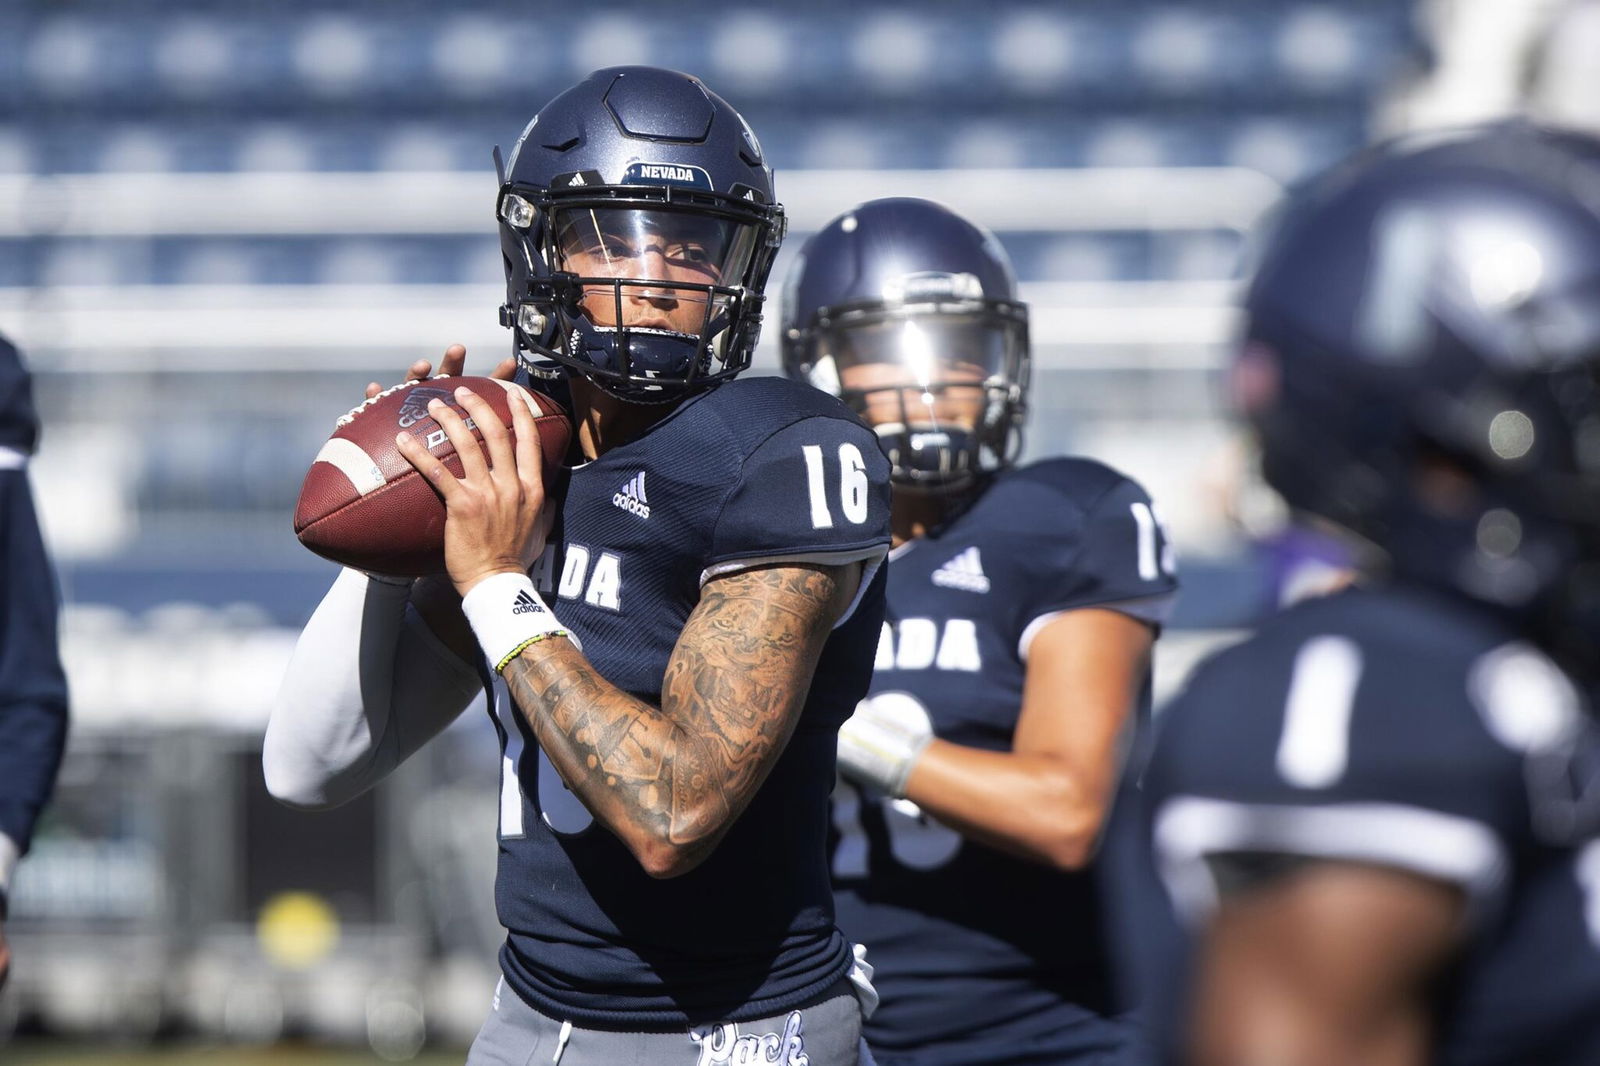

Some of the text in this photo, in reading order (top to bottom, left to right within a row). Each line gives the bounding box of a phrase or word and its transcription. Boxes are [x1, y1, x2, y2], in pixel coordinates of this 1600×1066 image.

[641, 165, 694, 182] NEVADA
[517, 354, 548, 379] SPORT
[801, 442, 868, 529] 16
[612, 492, 651, 519] adidas
[529, 542, 622, 614] ADA
[512, 603, 546, 615] adidas
[687, 1010, 810, 1066] Pack
